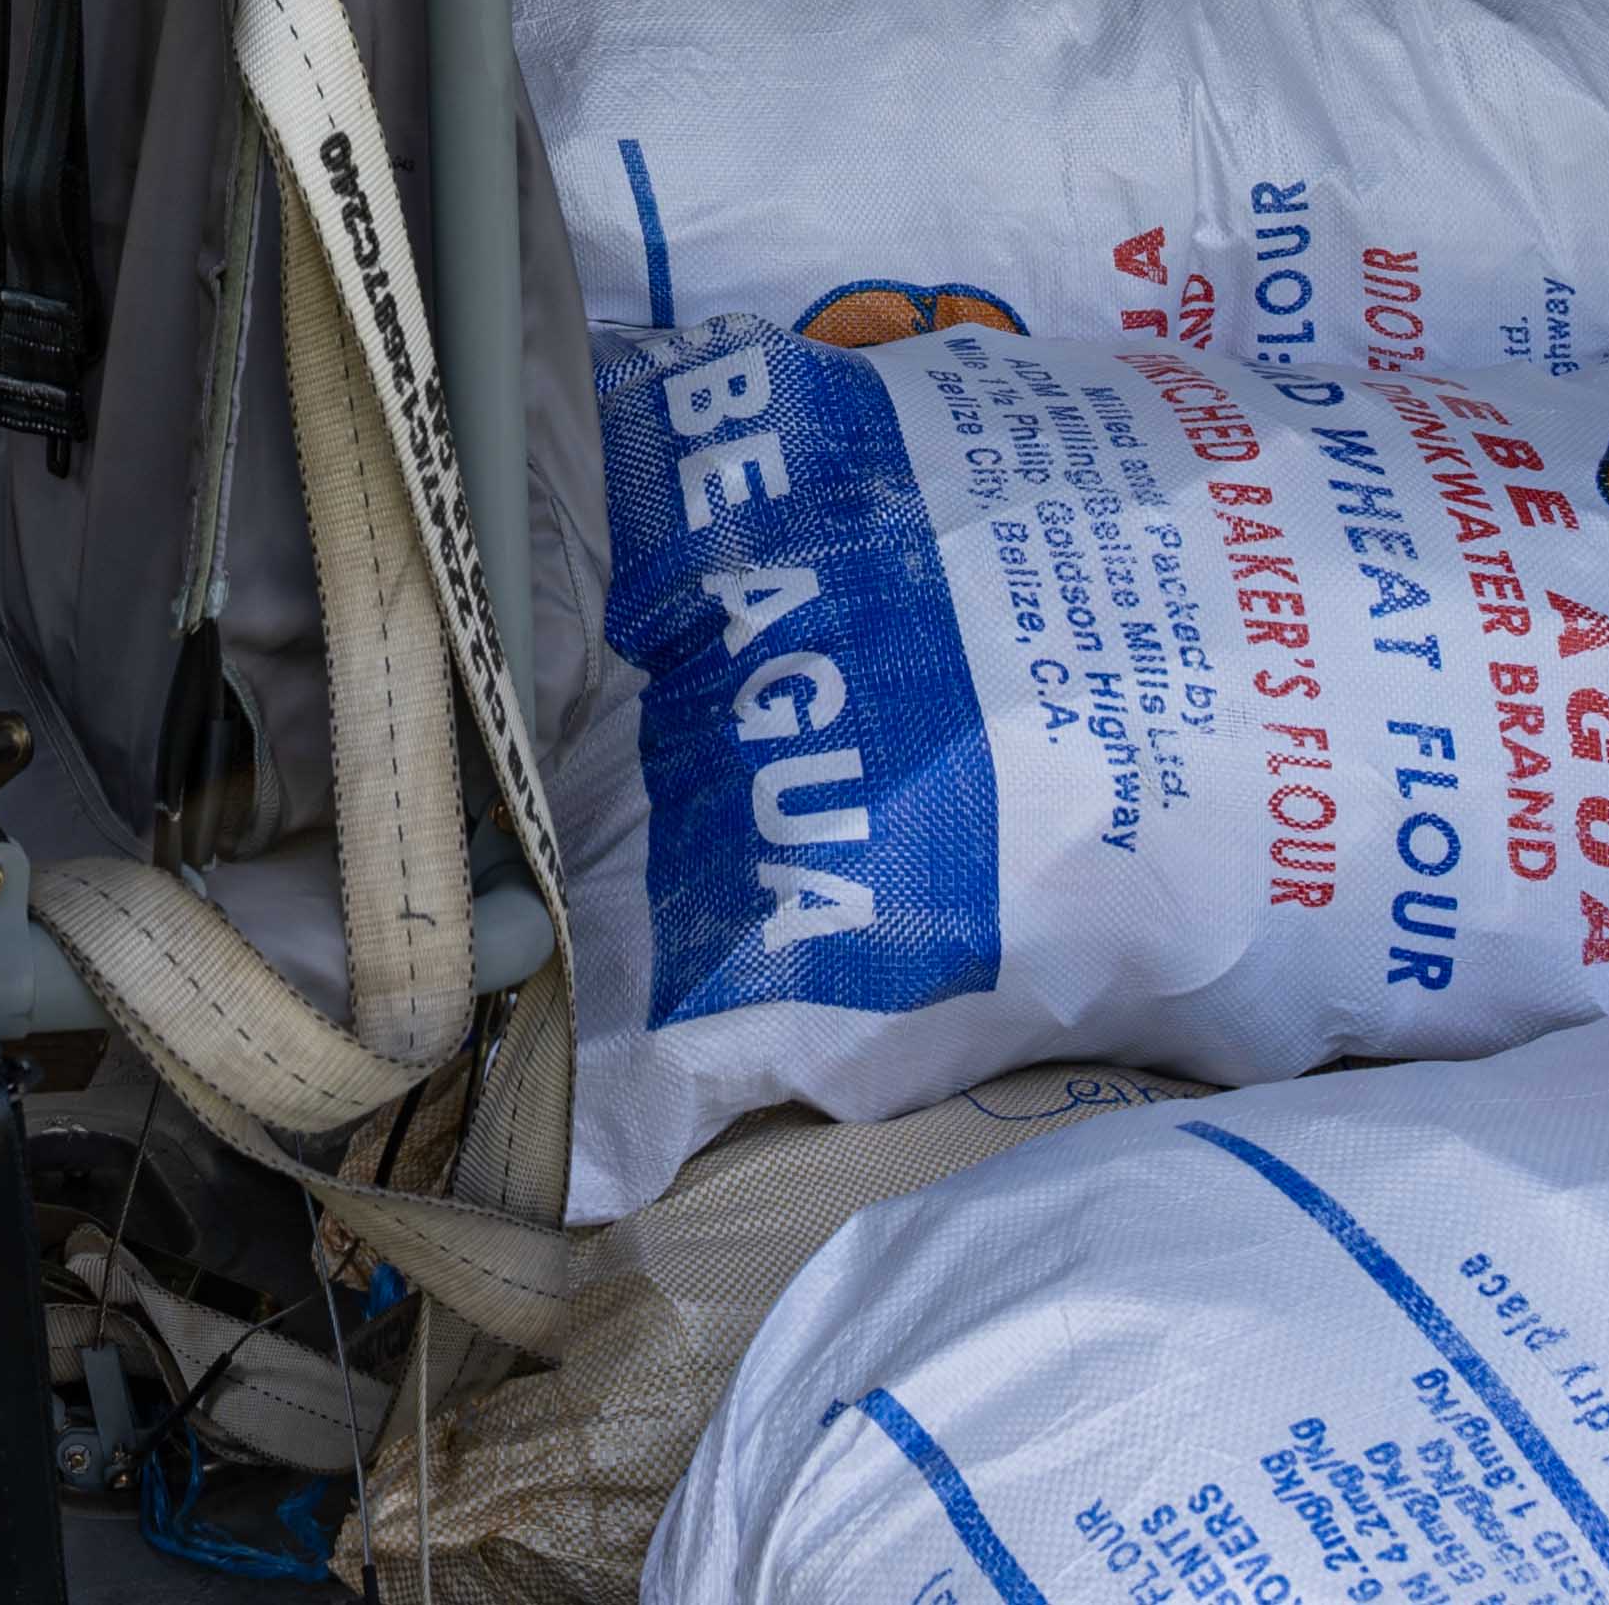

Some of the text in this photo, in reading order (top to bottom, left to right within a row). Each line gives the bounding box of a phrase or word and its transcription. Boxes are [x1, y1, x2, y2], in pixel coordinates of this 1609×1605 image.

[1251, 180, 1315, 363] LOUR
[1499, 316, 1533, 363] td.
[1543, 276, 1581, 377] ghway
[926, 368, 1082, 747] Belize City, Belize, C.A.
[943, 337, 991, 372] Mile
[1002, 411, 1053, 488] Philip
[1034, 496, 1105, 655] Goldson
[1085, 671, 1143, 855] Highway
[1002, 356, 1071, 399] ADM
[1122, 620, 1169, 717] Mills
[1147, 727, 1191, 810] Ltd.
[1080, 386, 1218, 736] Milled and Packed by
[1113, 354, 1261, 462] ENRICHED
[1260, 722, 1337, 909] FLOUR
[1311, 426, 1443, 673] WHEAT
[1385, 718, 1462, 992] FLOUR
[1361, 380, 1558, 883] DRINKWATER BRAND
[703, 565, 876, 953] AGUA
[1458, 1252, 1572, 1353] place
[1188, 1483, 1304, 1605] OVERS
